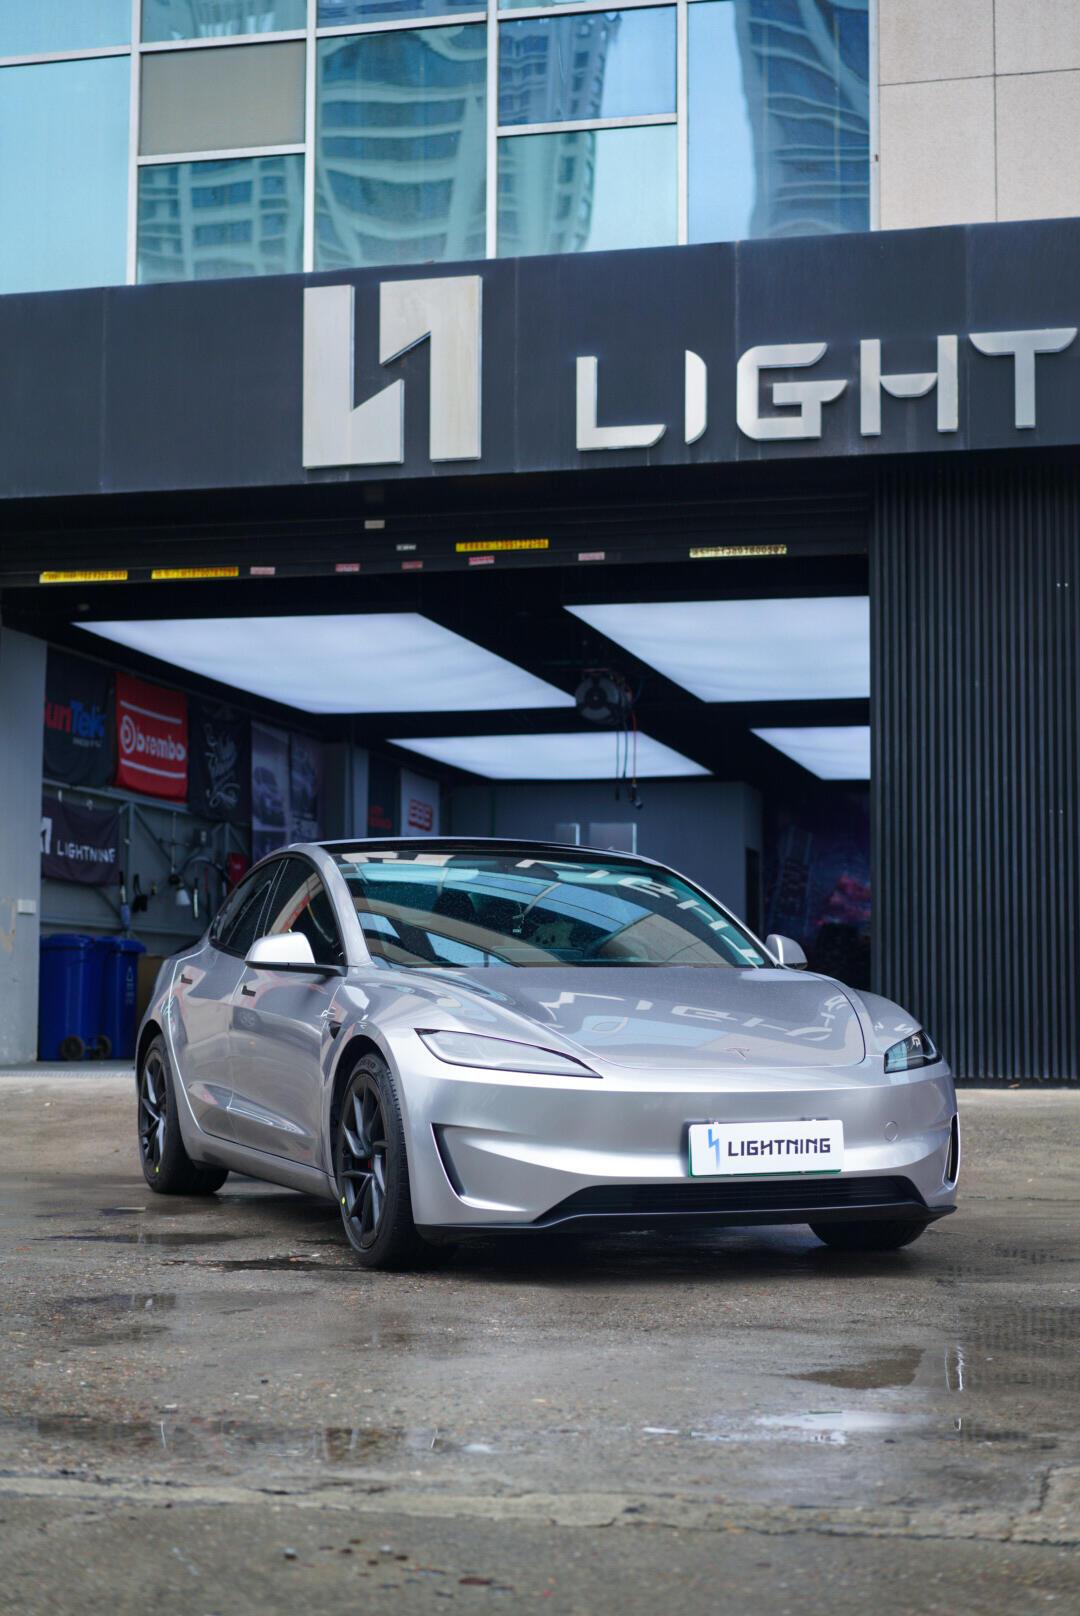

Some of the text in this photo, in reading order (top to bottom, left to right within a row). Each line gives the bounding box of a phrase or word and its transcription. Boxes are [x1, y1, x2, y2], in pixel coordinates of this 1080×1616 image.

[576, 327, 1078, 451] LIGHT
[45, 699, 105, 736] unTek
[136, 727, 185, 760] brembo
[727, 1137, 832, 1157] LIGHTNING
